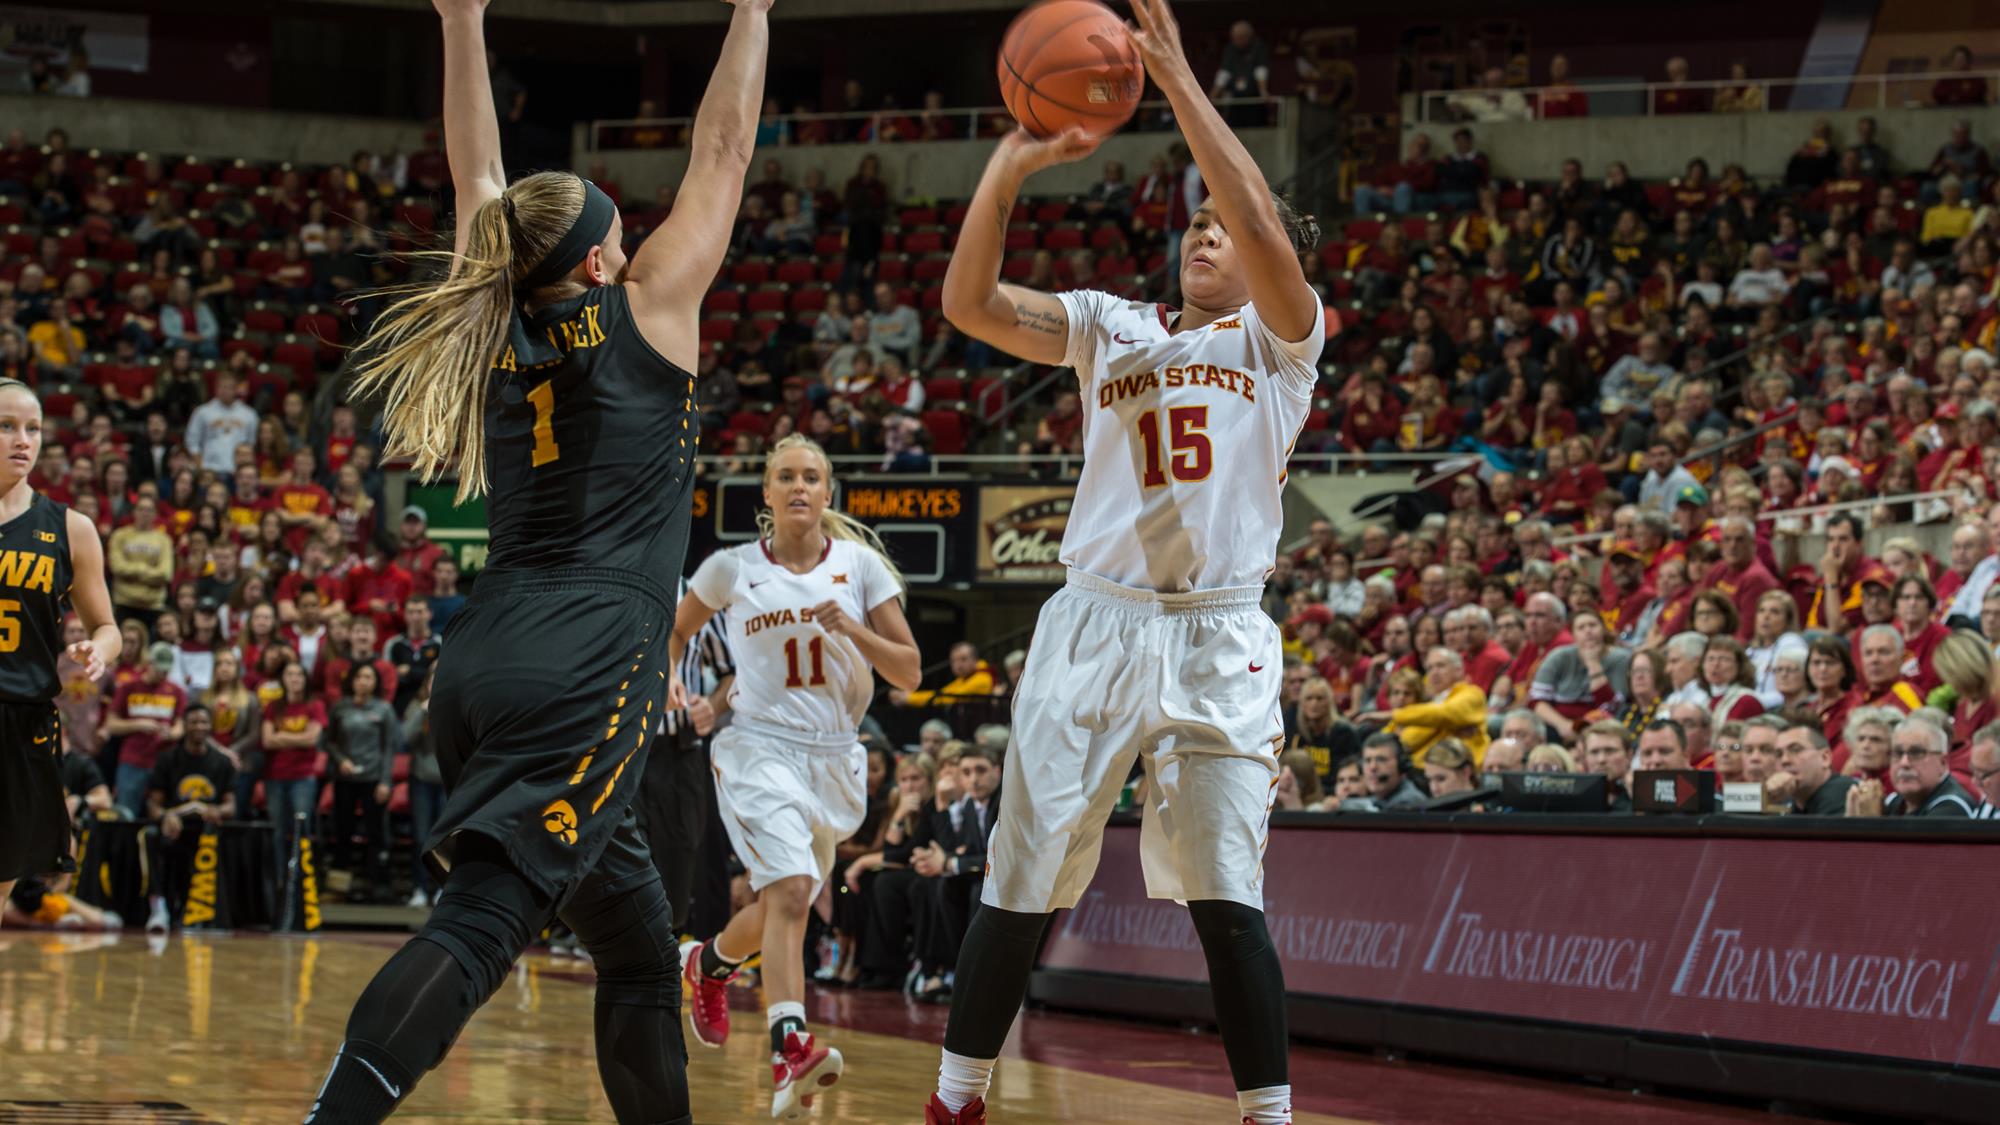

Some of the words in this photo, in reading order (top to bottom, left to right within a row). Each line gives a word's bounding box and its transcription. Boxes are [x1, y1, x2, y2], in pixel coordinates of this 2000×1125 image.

[1100, 371, 1160, 409] OWA
[1165, 364, 1256, 404] STATE
[527, 379, 560, 469] 1
[1138, 405, 1213, 488] 15
[847, 488, 960, 518] HAWKEYES
[745, 608, 796, 636] IOWA
[784, 635, 826, 688] 11
[182, 834, 218, 927] IOWA
